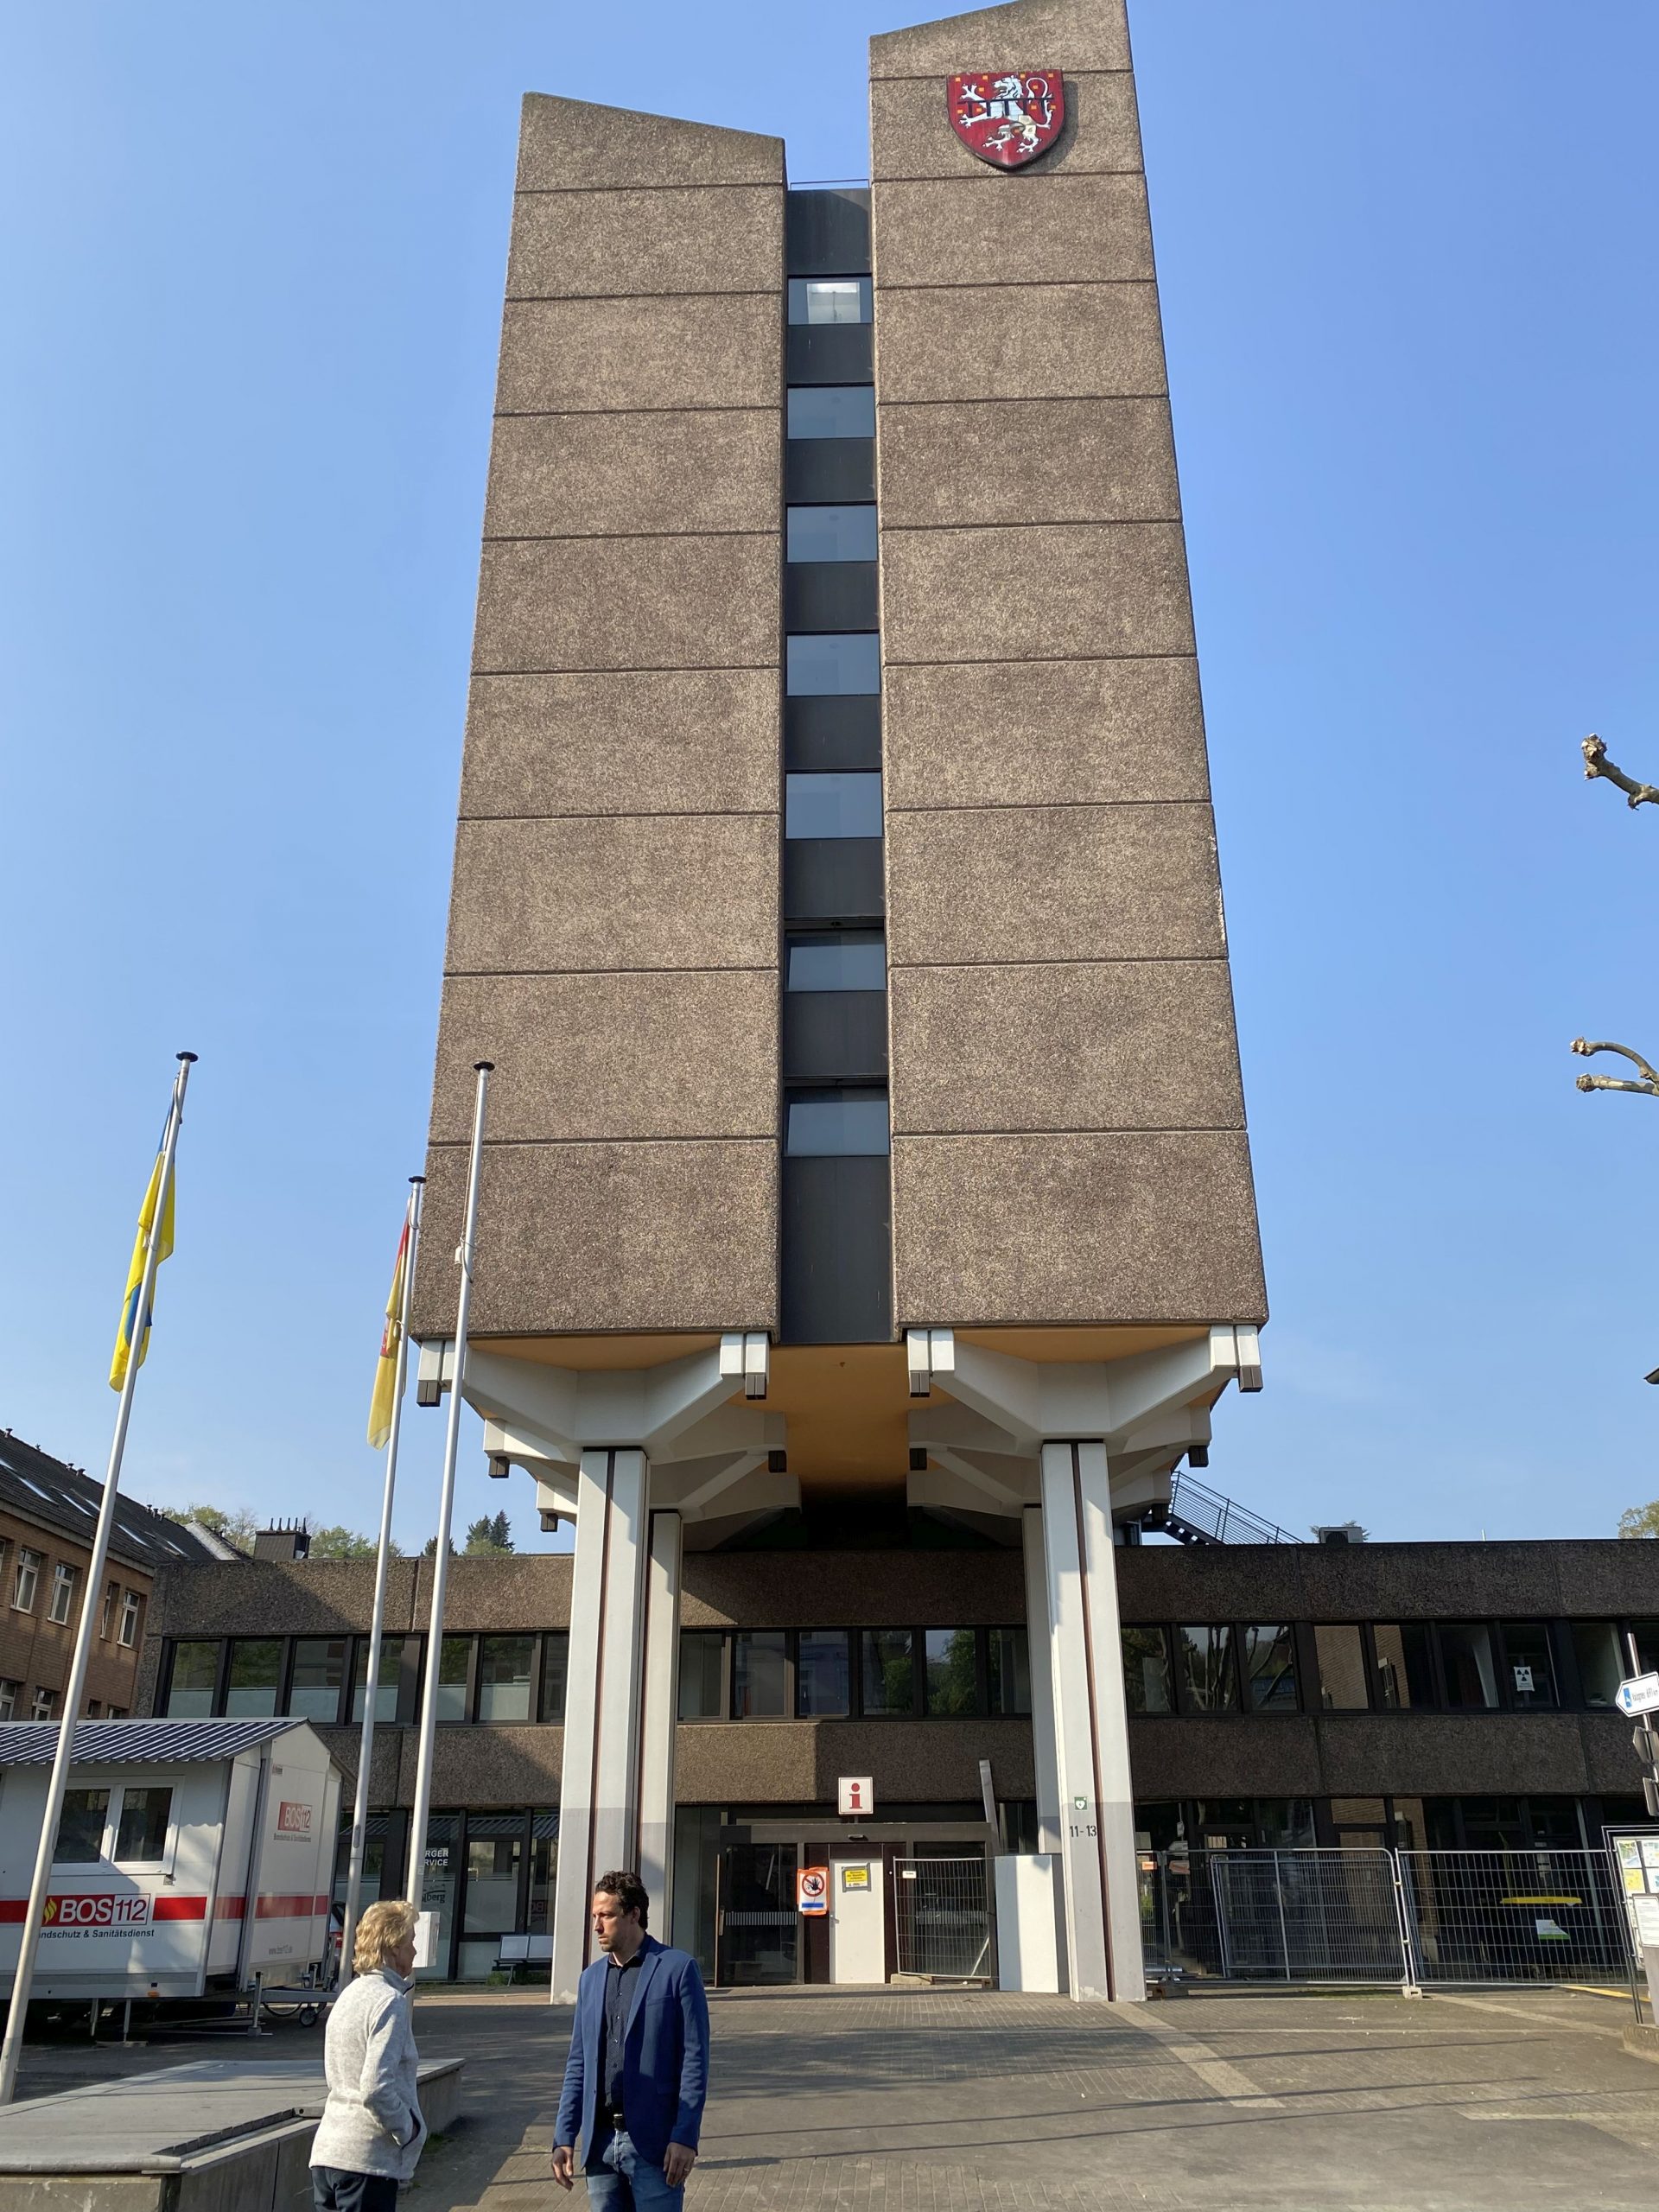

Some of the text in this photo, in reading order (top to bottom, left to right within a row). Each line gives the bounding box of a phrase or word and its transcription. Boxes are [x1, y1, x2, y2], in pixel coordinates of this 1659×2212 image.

[422, 1893, 446, 1904] lberg
[39, 1929, 155, 1938] ndschutz & Sanitätsdienst
